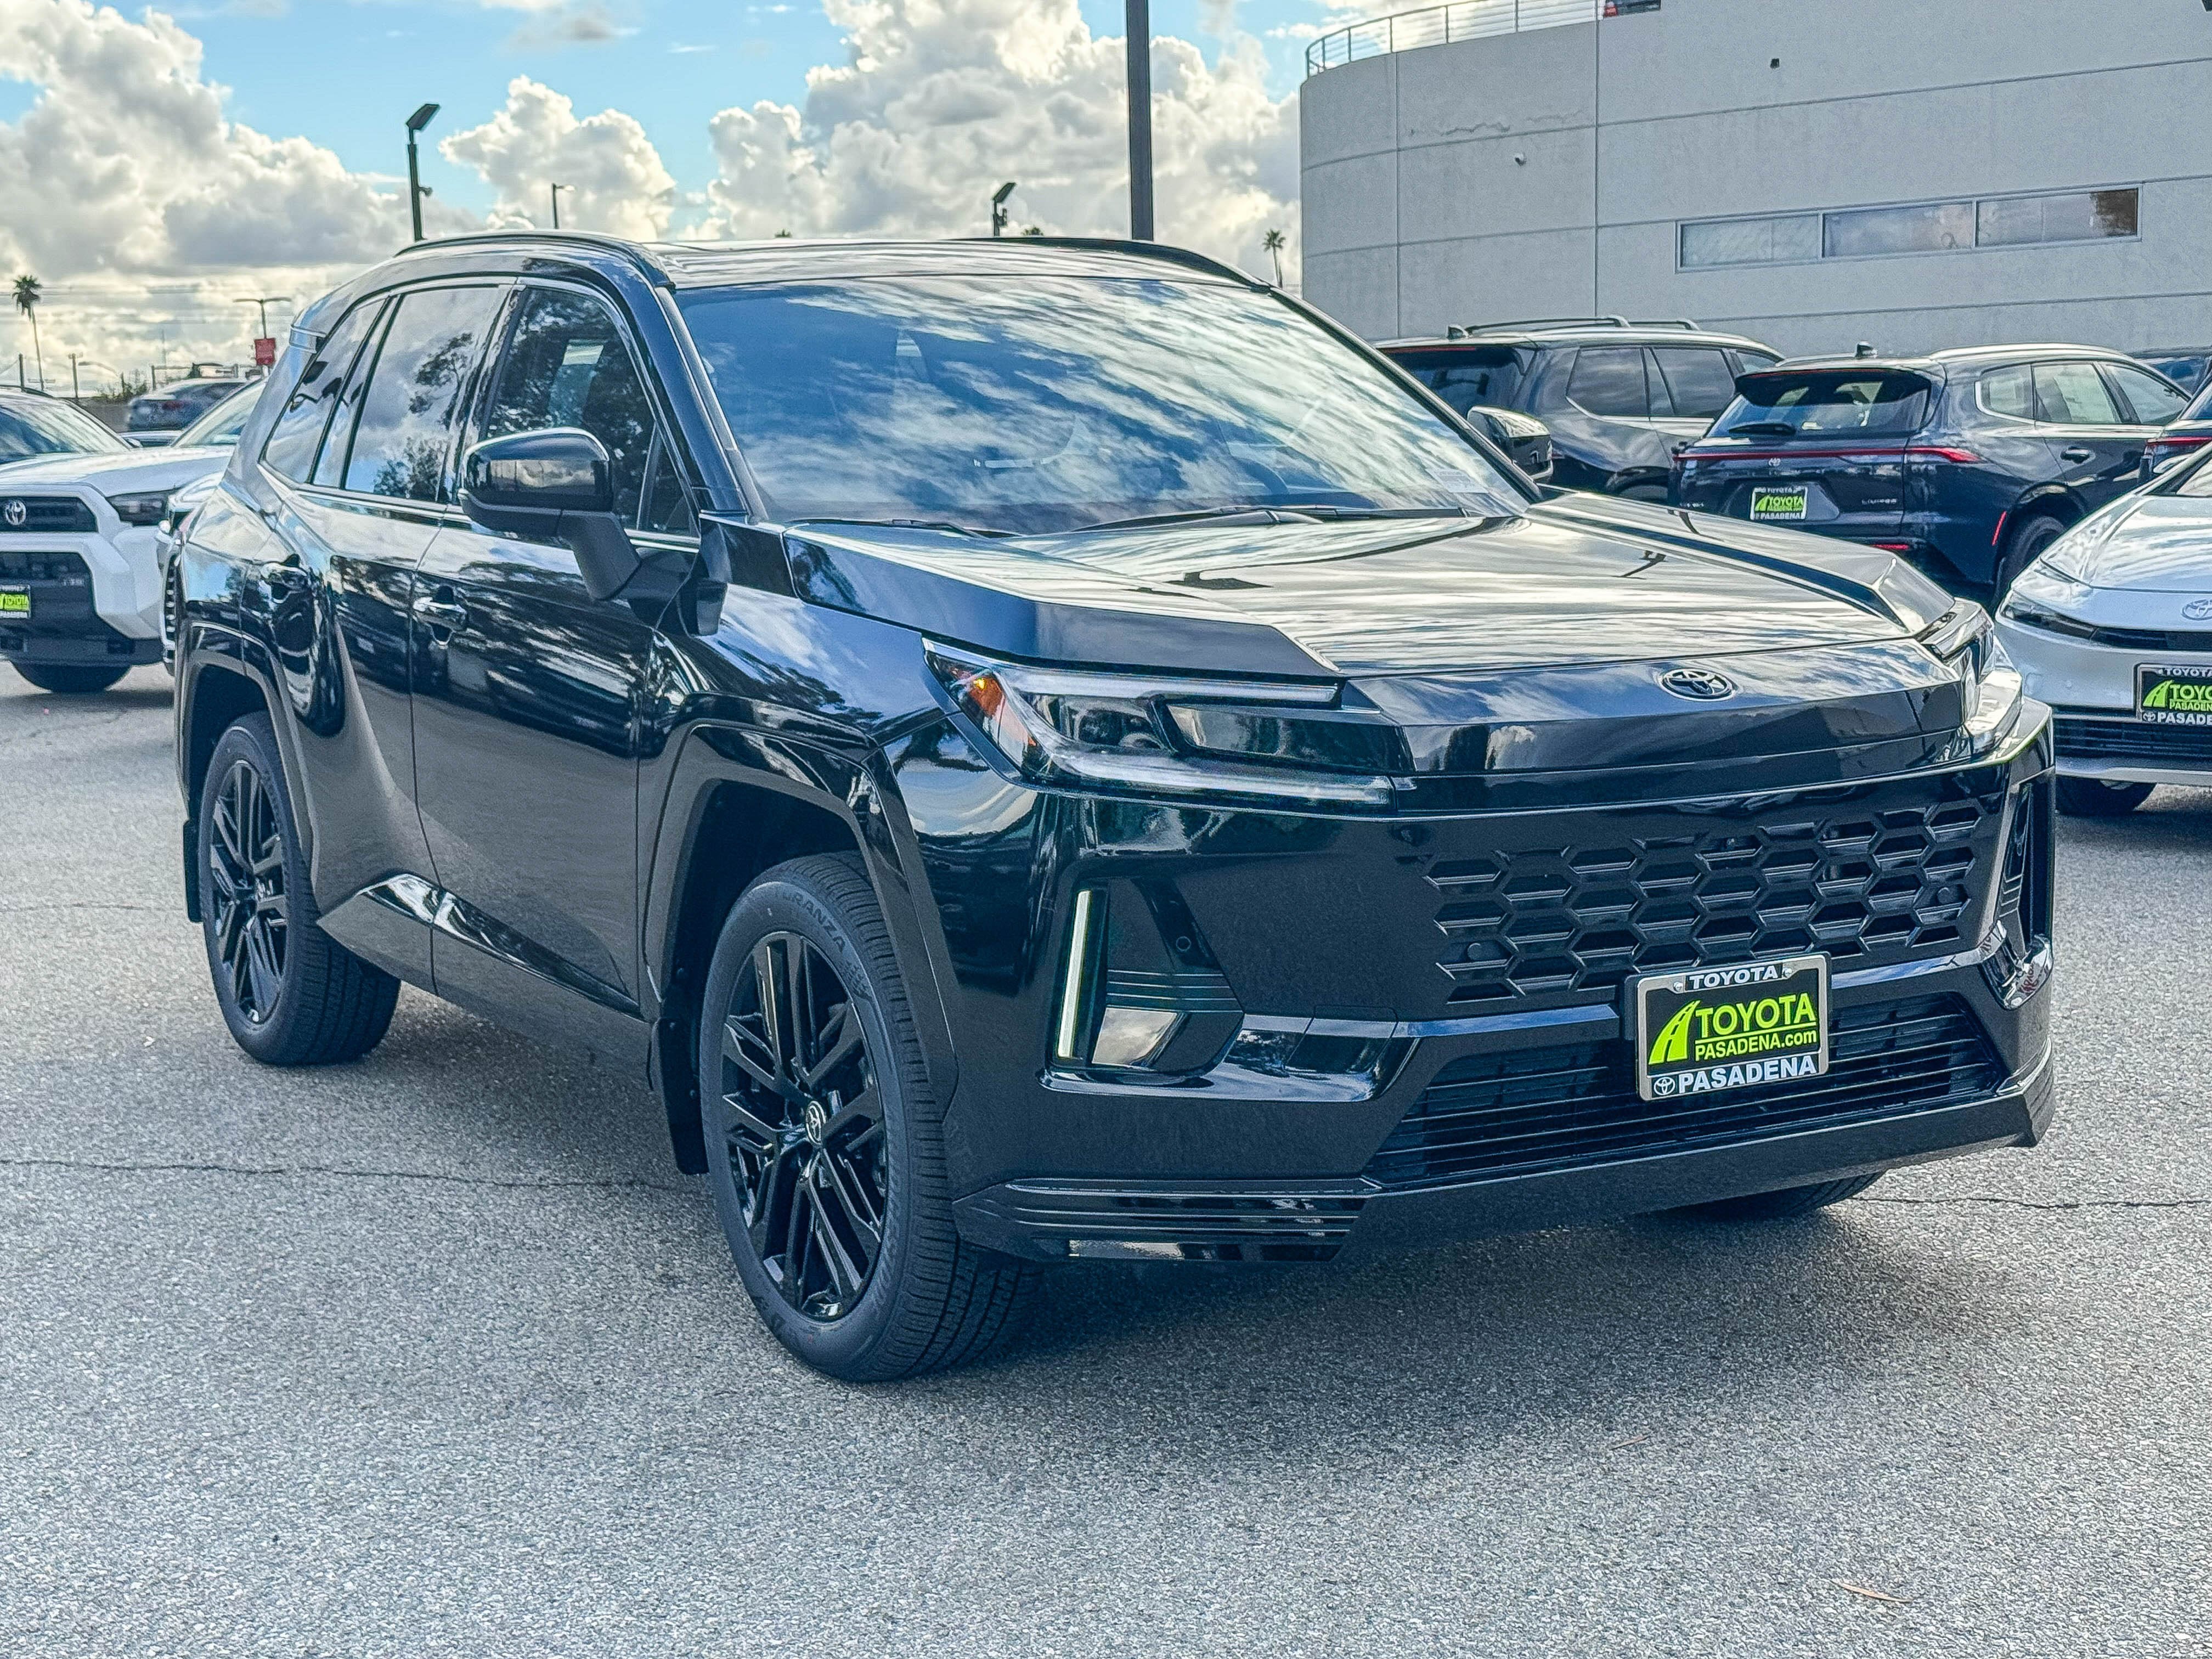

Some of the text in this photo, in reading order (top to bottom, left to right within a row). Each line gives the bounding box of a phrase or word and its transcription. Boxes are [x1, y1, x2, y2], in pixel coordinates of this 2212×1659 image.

[1768, 495, 1804, 505] TOYOTA
[4, 594, 29, 605] TOYOTA
[1689, 965, 1779, 990] TOYOTA
[1695, 992, 1816, 1038] TOYOTA
[1695, 1029, 1817, 1062] PASADENA.com
[1678, 1054, 1816, 1094] PASADENA
